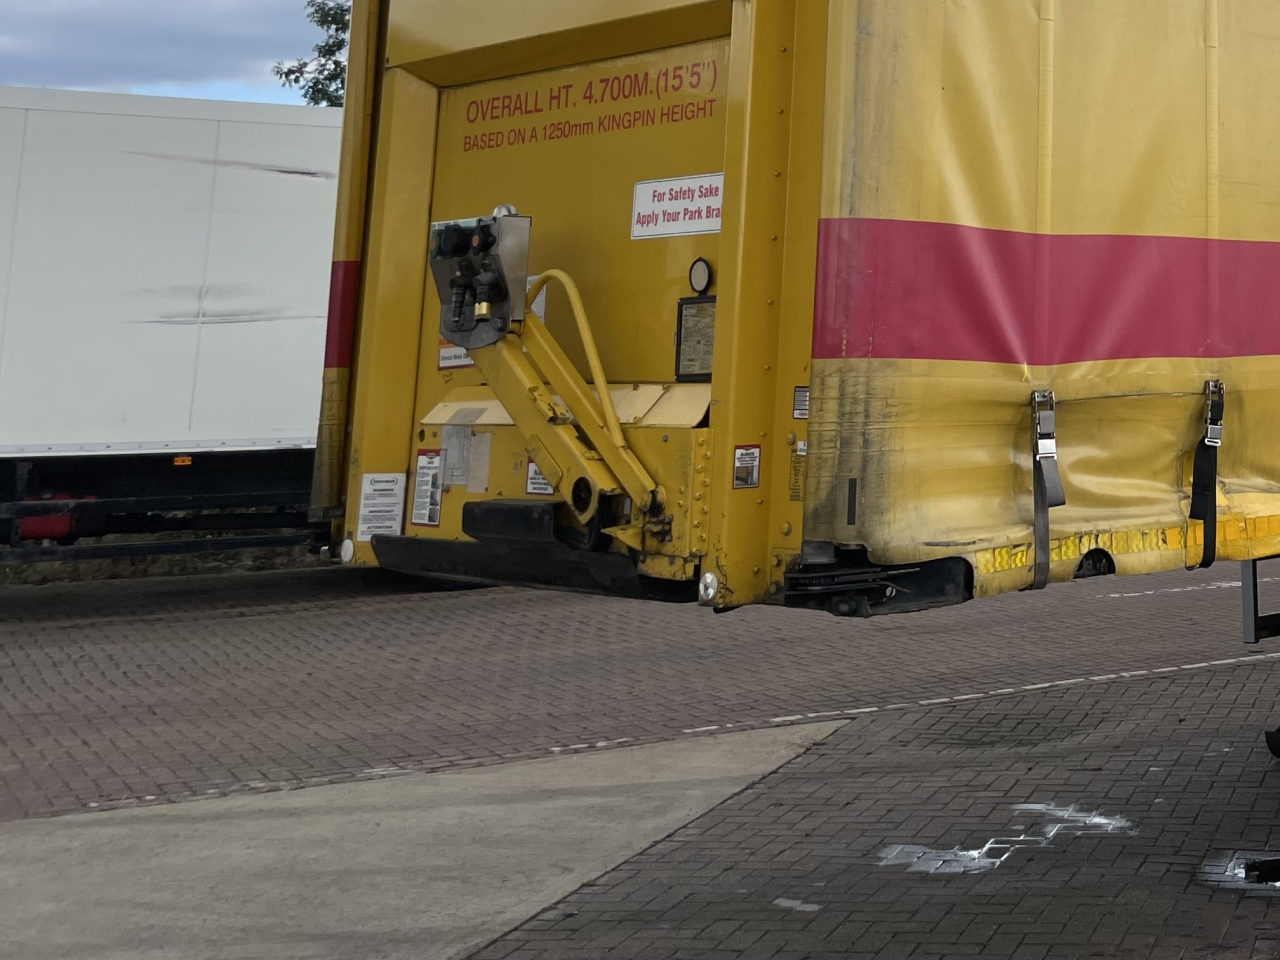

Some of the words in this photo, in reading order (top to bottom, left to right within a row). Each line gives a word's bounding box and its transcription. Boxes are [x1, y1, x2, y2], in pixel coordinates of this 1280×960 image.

[466, 90, 544, 124] OVERALL
[548, 84, 577, 111] HT.
[463, 131, 504, 152] BASED
[507, 127, 527, 146] ON
[529, 126, 538, 143] A
[542, 121, 594, 141] 1250mm
[598, 108, 656, 133] KINGPIN
[660, 99, 717, 124] HEIGHT
[652, 189, 666, 203] For
[668, 186, 696, 202] Safety
[698, 184, 719, 199] Sake
[636, 210, 659, 227] Apply
[662, 209, 681, 223] Your
[683, 206, 703, 221] Park
[706, 205, 722, 219] Bra
